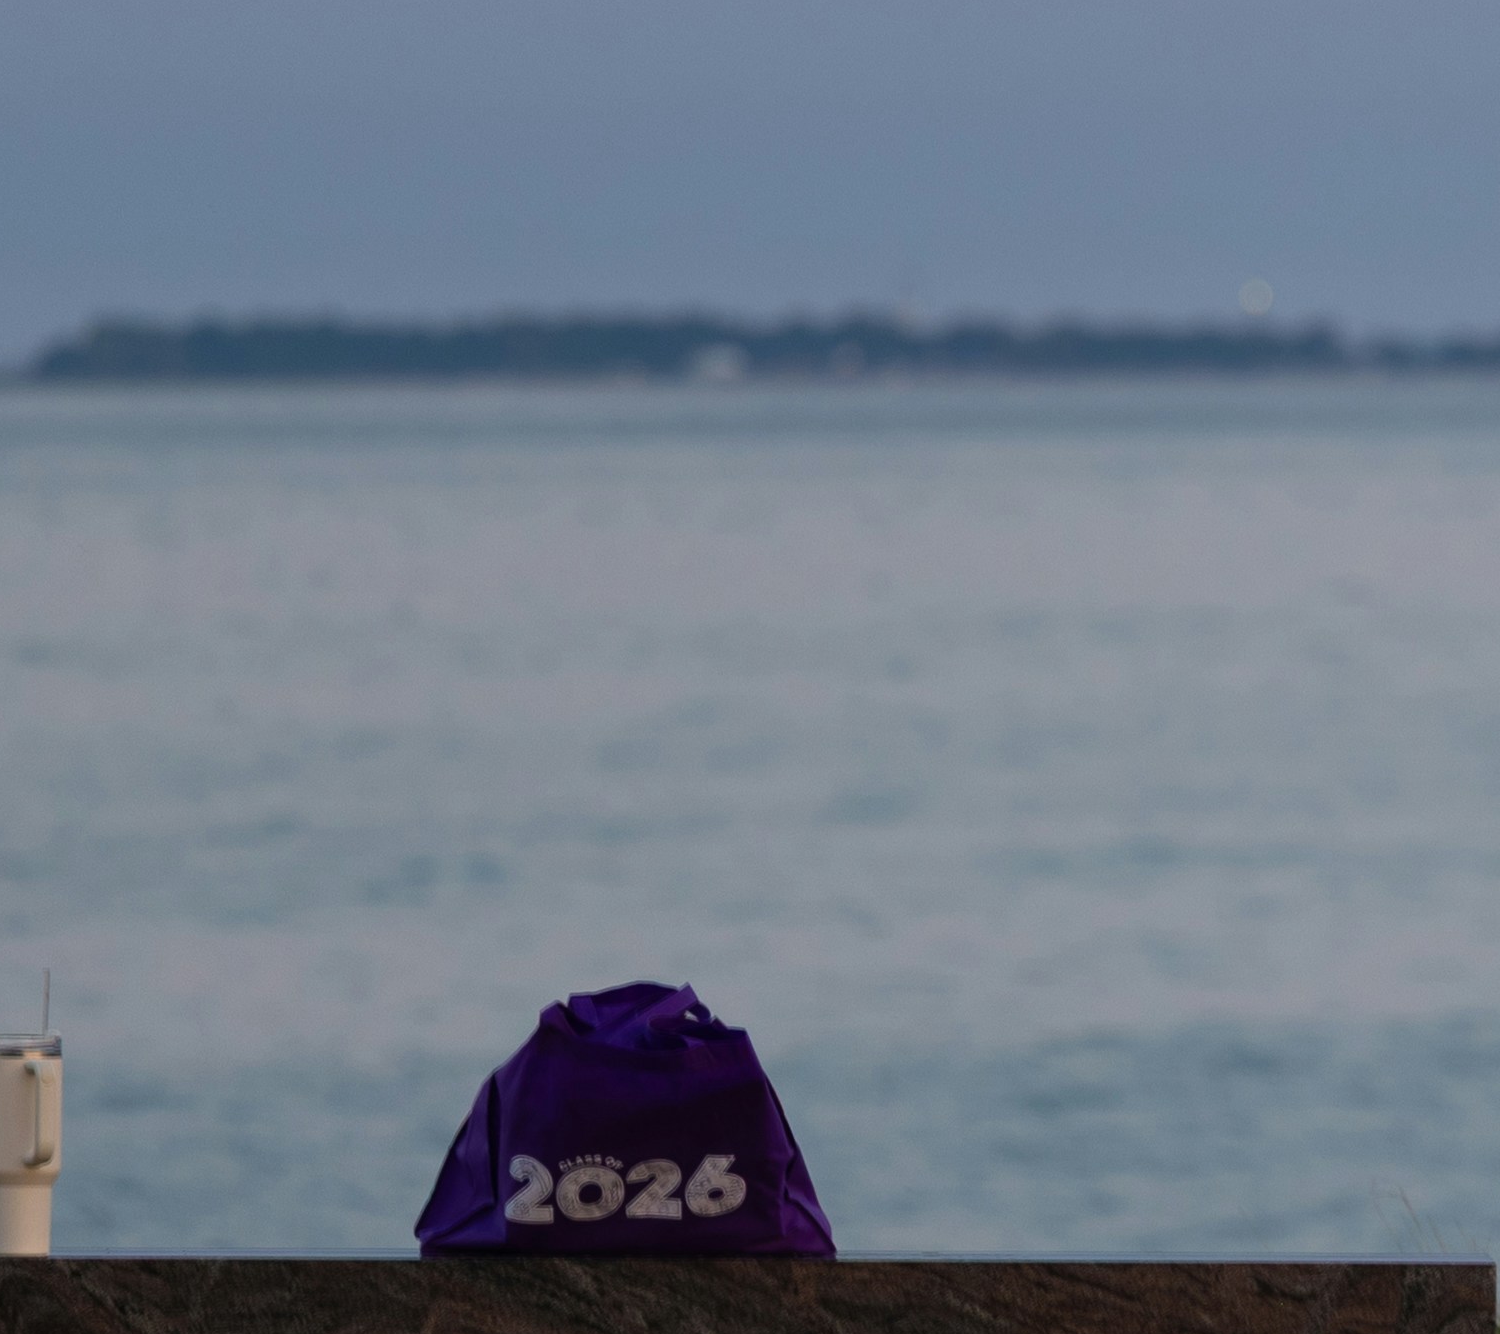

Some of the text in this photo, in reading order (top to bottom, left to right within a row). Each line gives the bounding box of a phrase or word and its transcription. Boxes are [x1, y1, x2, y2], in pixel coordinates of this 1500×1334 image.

[558, 1154, 624, 1173] CLASS OF
[504, 1154, 747, 1224] 2026
